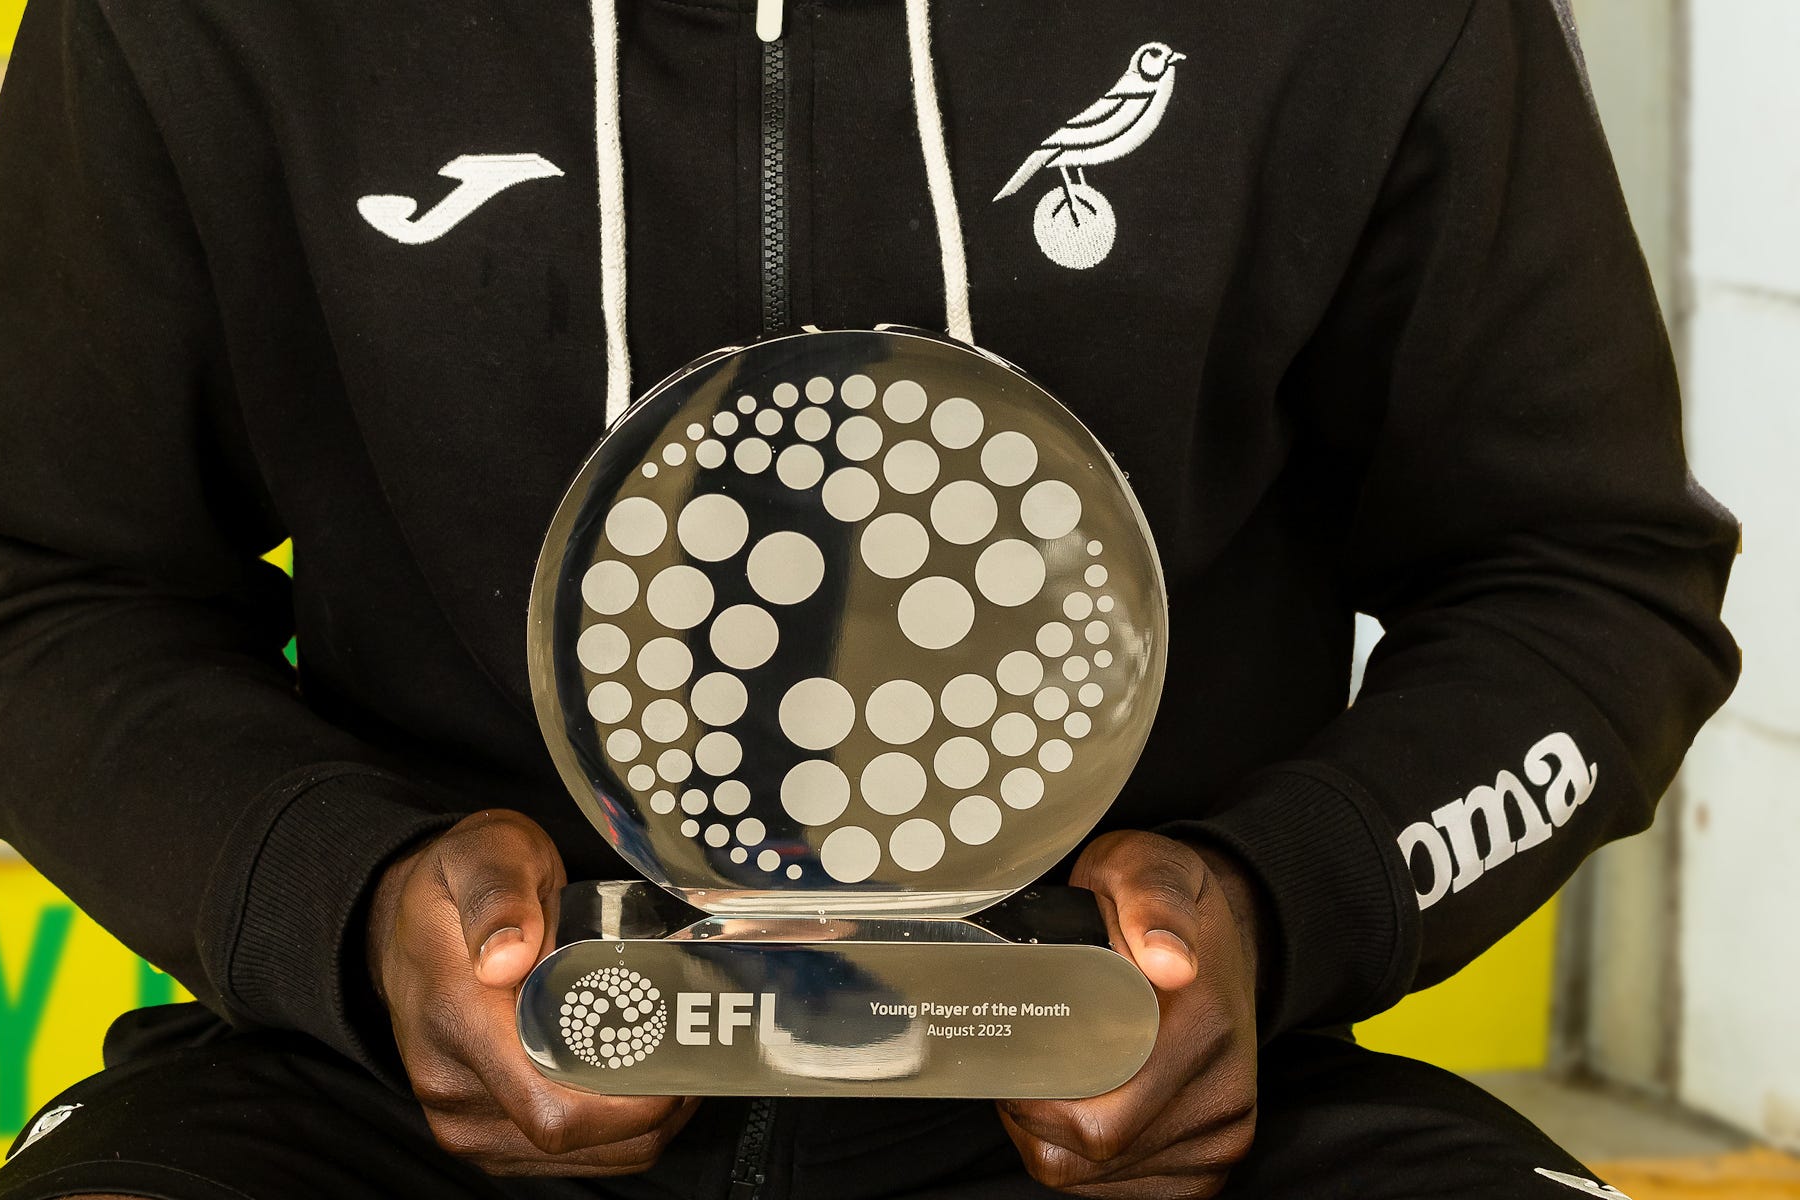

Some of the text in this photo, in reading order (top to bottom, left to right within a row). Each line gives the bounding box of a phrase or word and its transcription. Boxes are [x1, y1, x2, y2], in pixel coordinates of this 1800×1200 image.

[1397, 732, 1597, 911] oma
[676, 992, 792, 1046] EFL
[869, 1002, 1071, 1019] Young Player of the Month
[926, 1023, 1012, 1039] August 2023
